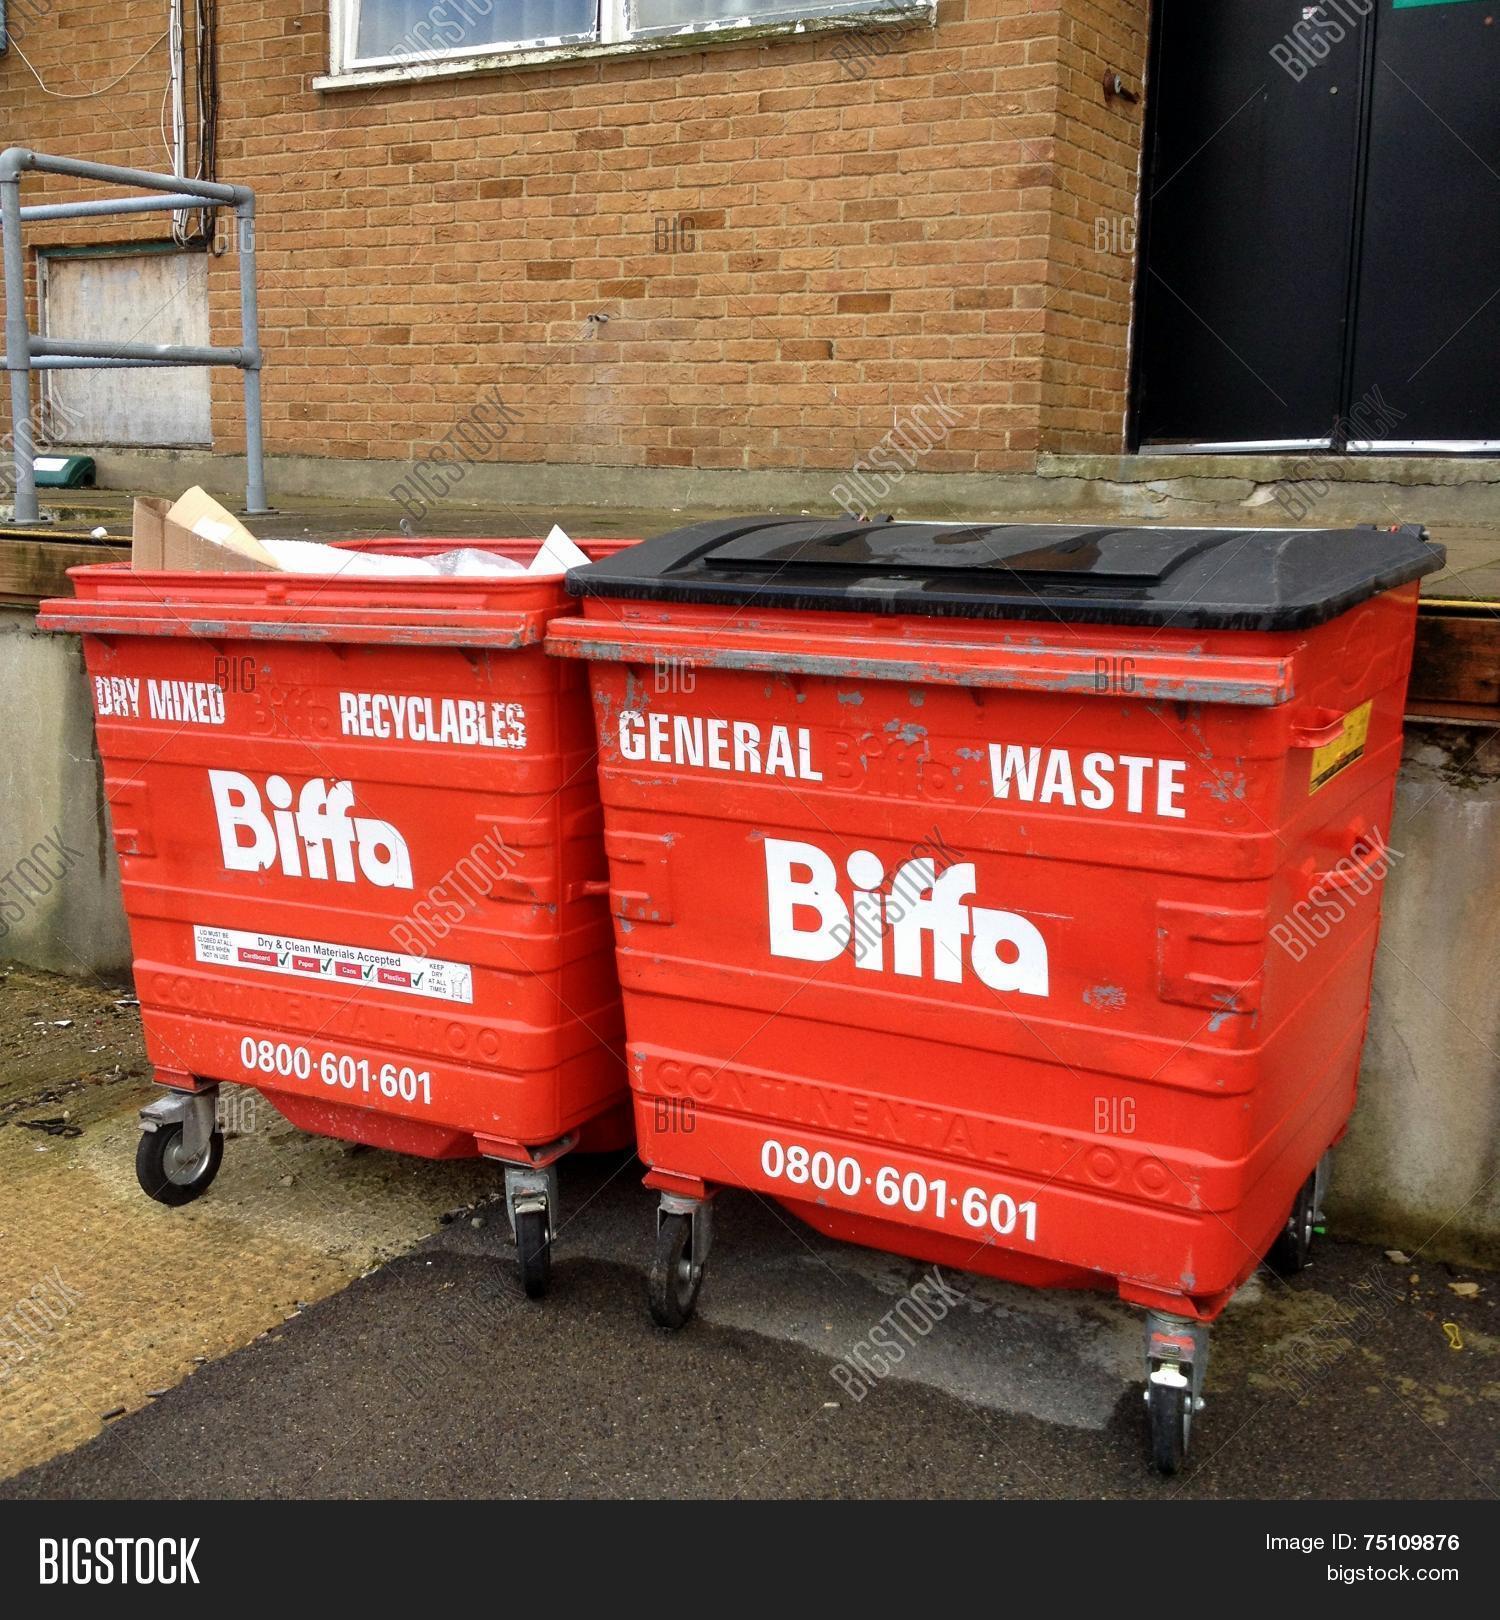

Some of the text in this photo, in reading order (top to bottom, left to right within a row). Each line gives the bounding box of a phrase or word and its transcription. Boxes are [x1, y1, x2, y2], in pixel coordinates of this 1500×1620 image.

[95, 675, 226, 725] DRY MIXED
[339, 692, 527, 750] RECYCLABLES
[618, 710, 823, 782] GENERAL
[988, 743, 1186, 819] WASTE
[207, 769, 414, 890] Biffa
[763, 837, 1050, 998] Biffa
[242, 951, 271, 962] Cardboard
[257, 937, 401, 967] Dry & Clean Materials Accepted
[298, 959, 314, 968] Paper
[342, 966, 357, 975] Cans
[383, 973, 406, 983] Plastics
[436, 979, 447, 987] ALL
[429, 985, 447, 994] TIMES
